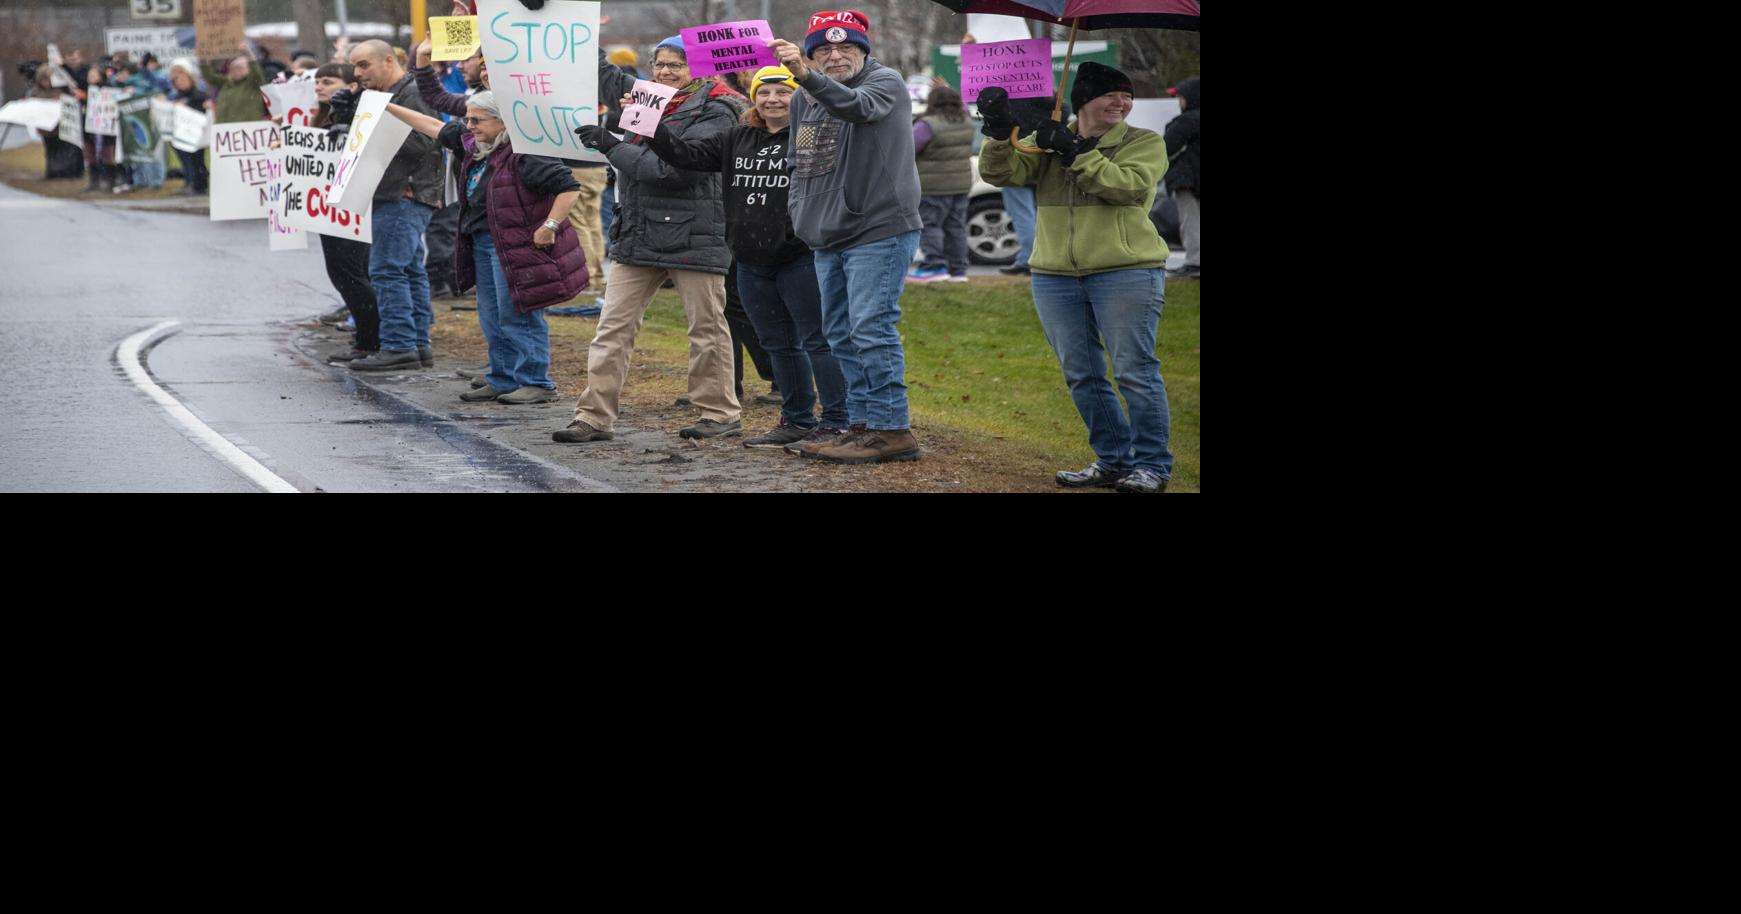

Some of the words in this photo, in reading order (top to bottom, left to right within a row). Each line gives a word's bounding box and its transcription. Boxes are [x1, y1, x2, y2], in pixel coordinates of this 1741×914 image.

[135, 0, 175, 13] 35
[490, 12, 591, 64] STOP
[697, 27, 735, 43] HONK
[738, 27, 760, 38] FOR
[711, 45, 755, 58] MENTAL
[983, 44, 1026, 58] HONK
[714, 58, 759, 71] HEALTH
[986, 62, 1011, 70] STOP
[1014, 60, 1043, 68] CUTS
[986, 72, 1044, 83] ESSENTIAL
[509, 74, 553, 96] THE
[1017, 83, 1046, 93] CARE
[632, 90, 667, 110] HONK
[216, 127, 280, 152] MENTA
[281, 125, 314, 148] TECHS
[757, 144, 781, 156] 5'2
[286, 154, 323, 177] UNITED
[735, 157, 765, 170] BUT
[732, 174, 789, 188] TTITUD
[282, 182, 303, 217] THE
[746, 193, 767, 206] 6'1
